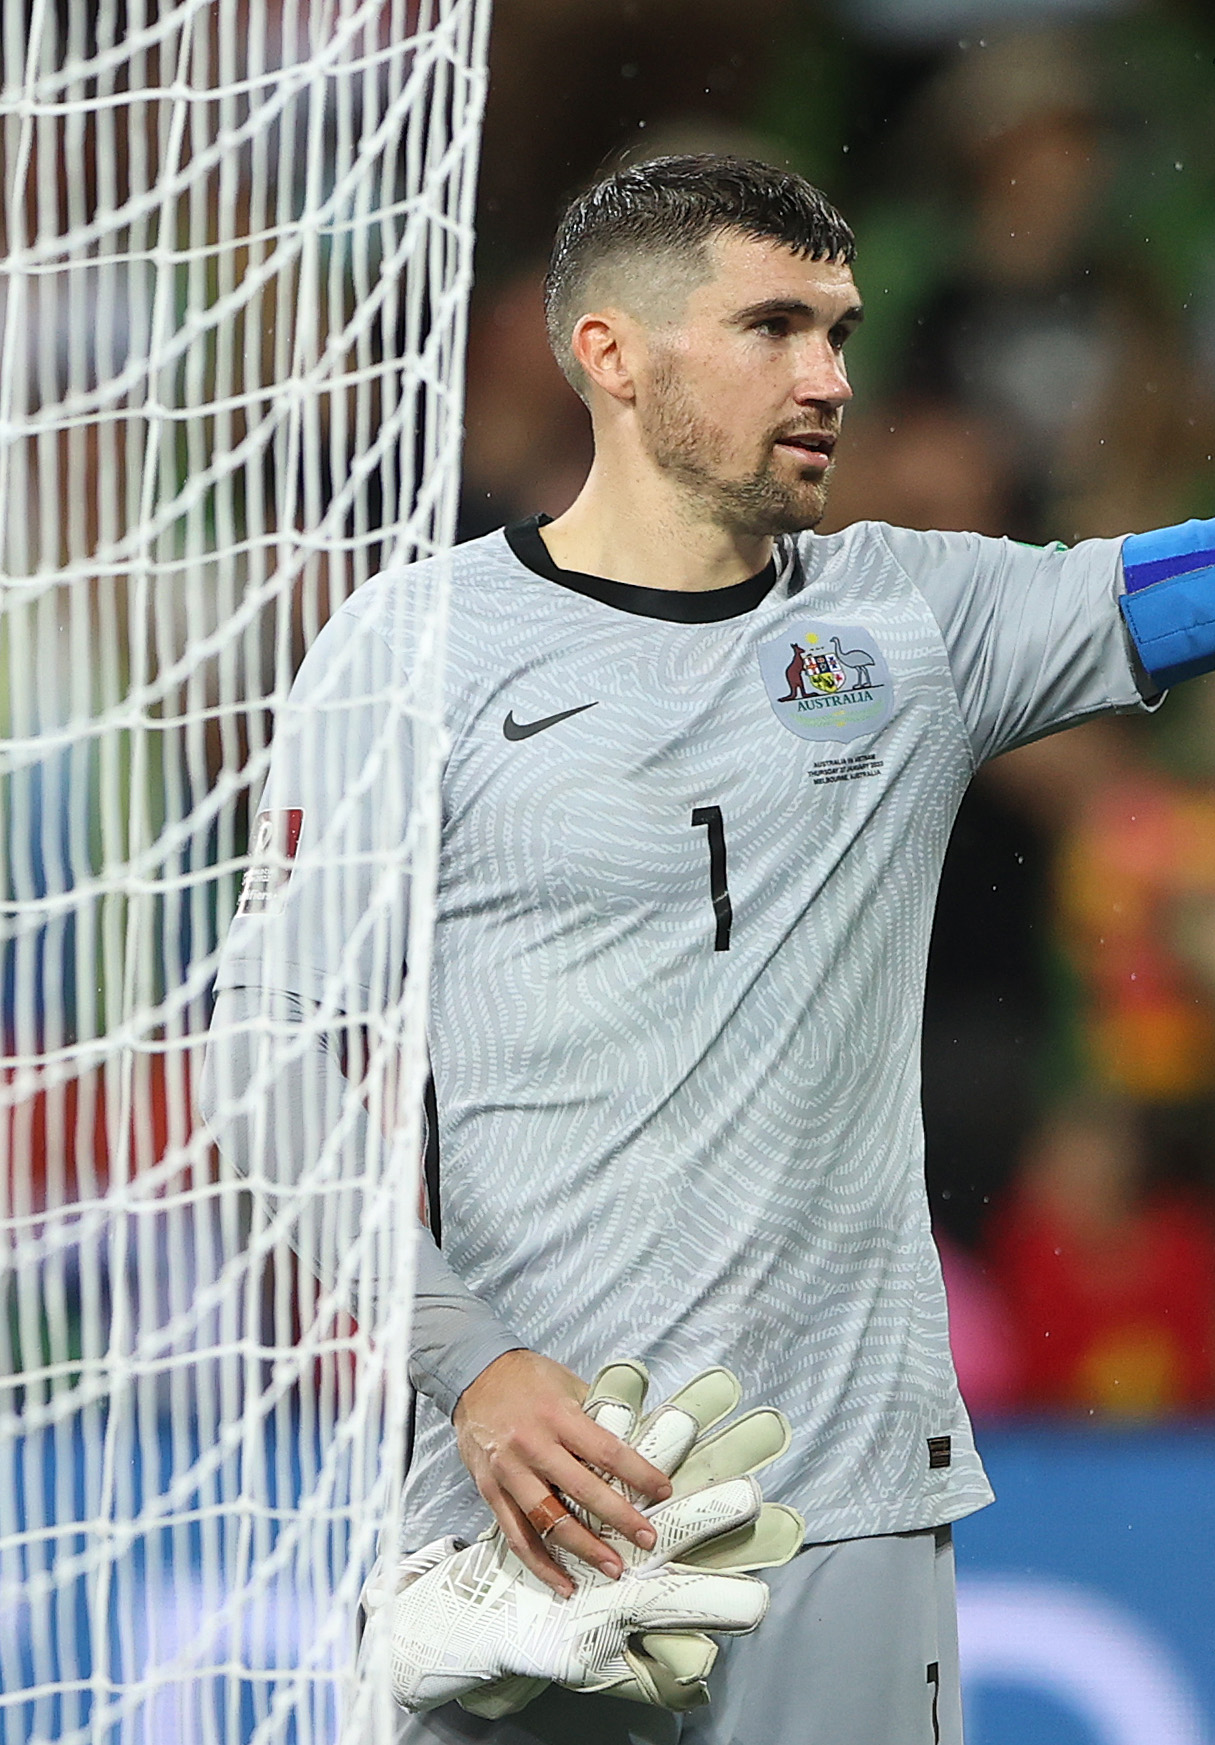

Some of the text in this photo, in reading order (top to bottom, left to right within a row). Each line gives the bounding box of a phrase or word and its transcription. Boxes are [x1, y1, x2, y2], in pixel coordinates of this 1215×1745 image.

[797, 691, 873, 712] AUSTRALIA
[814, 757, 847, 768] AUSTRALIA
[691, 805, 733, 951] 1
